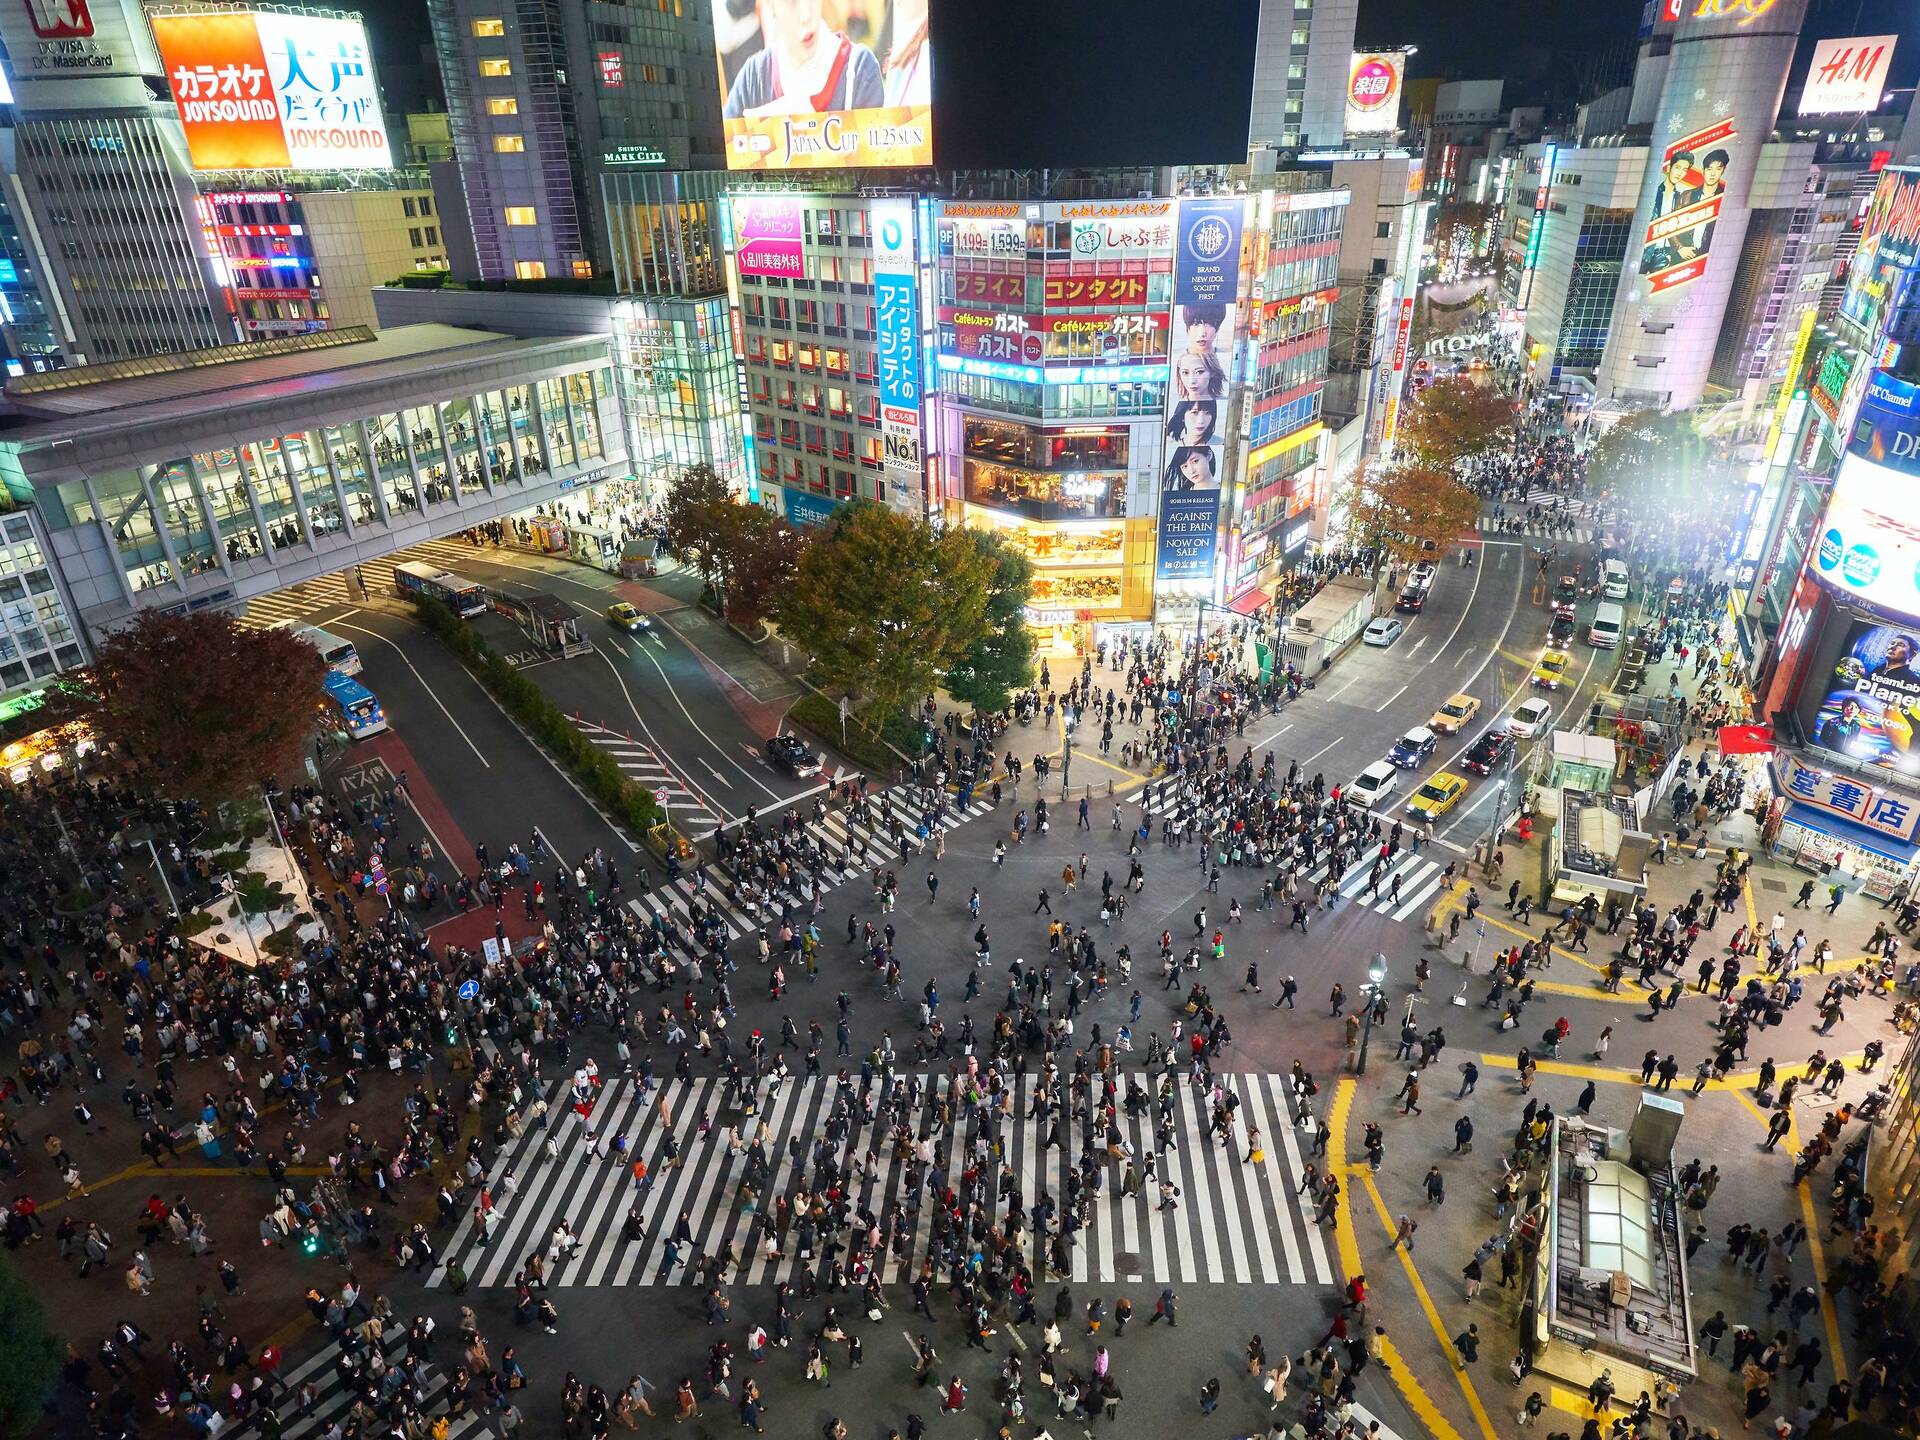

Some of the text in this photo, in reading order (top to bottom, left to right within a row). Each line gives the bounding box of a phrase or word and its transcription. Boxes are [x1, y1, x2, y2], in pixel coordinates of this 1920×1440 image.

[59, 40, 87, 54] VISA
[53, 54, 114, 69] MasterCard
[271, 36, 365, 93] 大声
[1816, 45, 1885, 85] H&M
[173, 63, 265, 99] カラオケ
[1353, 75, 1391, 95] 楽園
[184, 98, 277, 123] JOYSOUND
[282, 94, 373, 123] だそうぜ
[289, 128, 384, 150] JOYSOUND
[604, 151, 664, 161] MARK CITY
[214, 193, 243, 204] カラオケ
[762, 221, 794, 234] クリニック
[940, 230, 953, 244] 9F
[1106, 223, 1171, 248] しゃぶ葉
[747, 252, 801, 271] 品川美容外科
[956, 274, 1023, 298] プライス
[1045, 278, 1144, 300] コンタクト
[1191, 275, 1225, 283] NEW IDOL
[1193, 284, 1221, 292] SOCIETY
[995, 313, 1029, 334] ガスト
[1112, 315, 1159, 335] ガスト
[878, 285, 899, 398] アイシティ
[898, 286, 915, 401] コンタクトの
[941, 332, 956, 347] 7F
[978, 333, 1018, 358] ガスト
[1881, 388, 1913, 408] Channel
[884, 432, 919, 464] No.1
[1168, 511, 1213, 522] AGAINST
[1166, 522, 1213, 532] THE PAIN
[1166, 538, 1210, 548] NOW ON
[1176, 547, 1198, 557] SALE
[1857, 599, 1876, 612] DHC
[1871, 672, 1920, 694] teamLab
